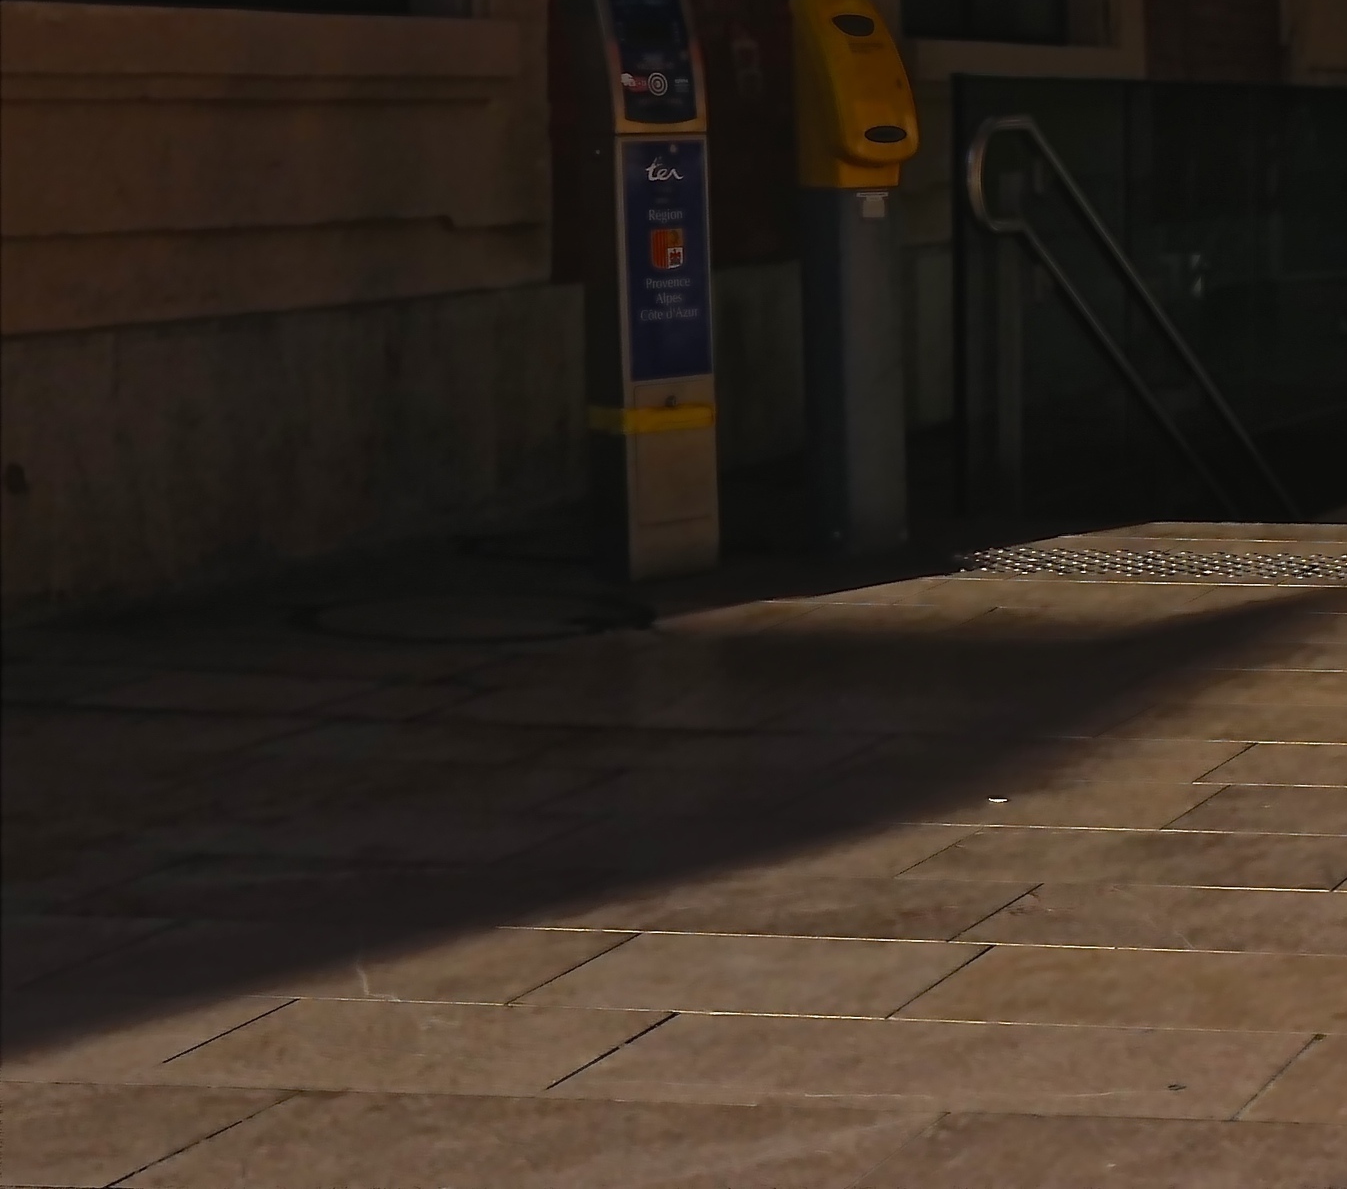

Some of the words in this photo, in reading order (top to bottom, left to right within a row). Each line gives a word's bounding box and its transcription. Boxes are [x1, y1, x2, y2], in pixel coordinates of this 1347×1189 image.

[645, 156, 684, 181] ter
[648, 209, 683, 223] Région
[645, 277, 691, 289] Provence
[655, 292, 683, 305] Alpes
